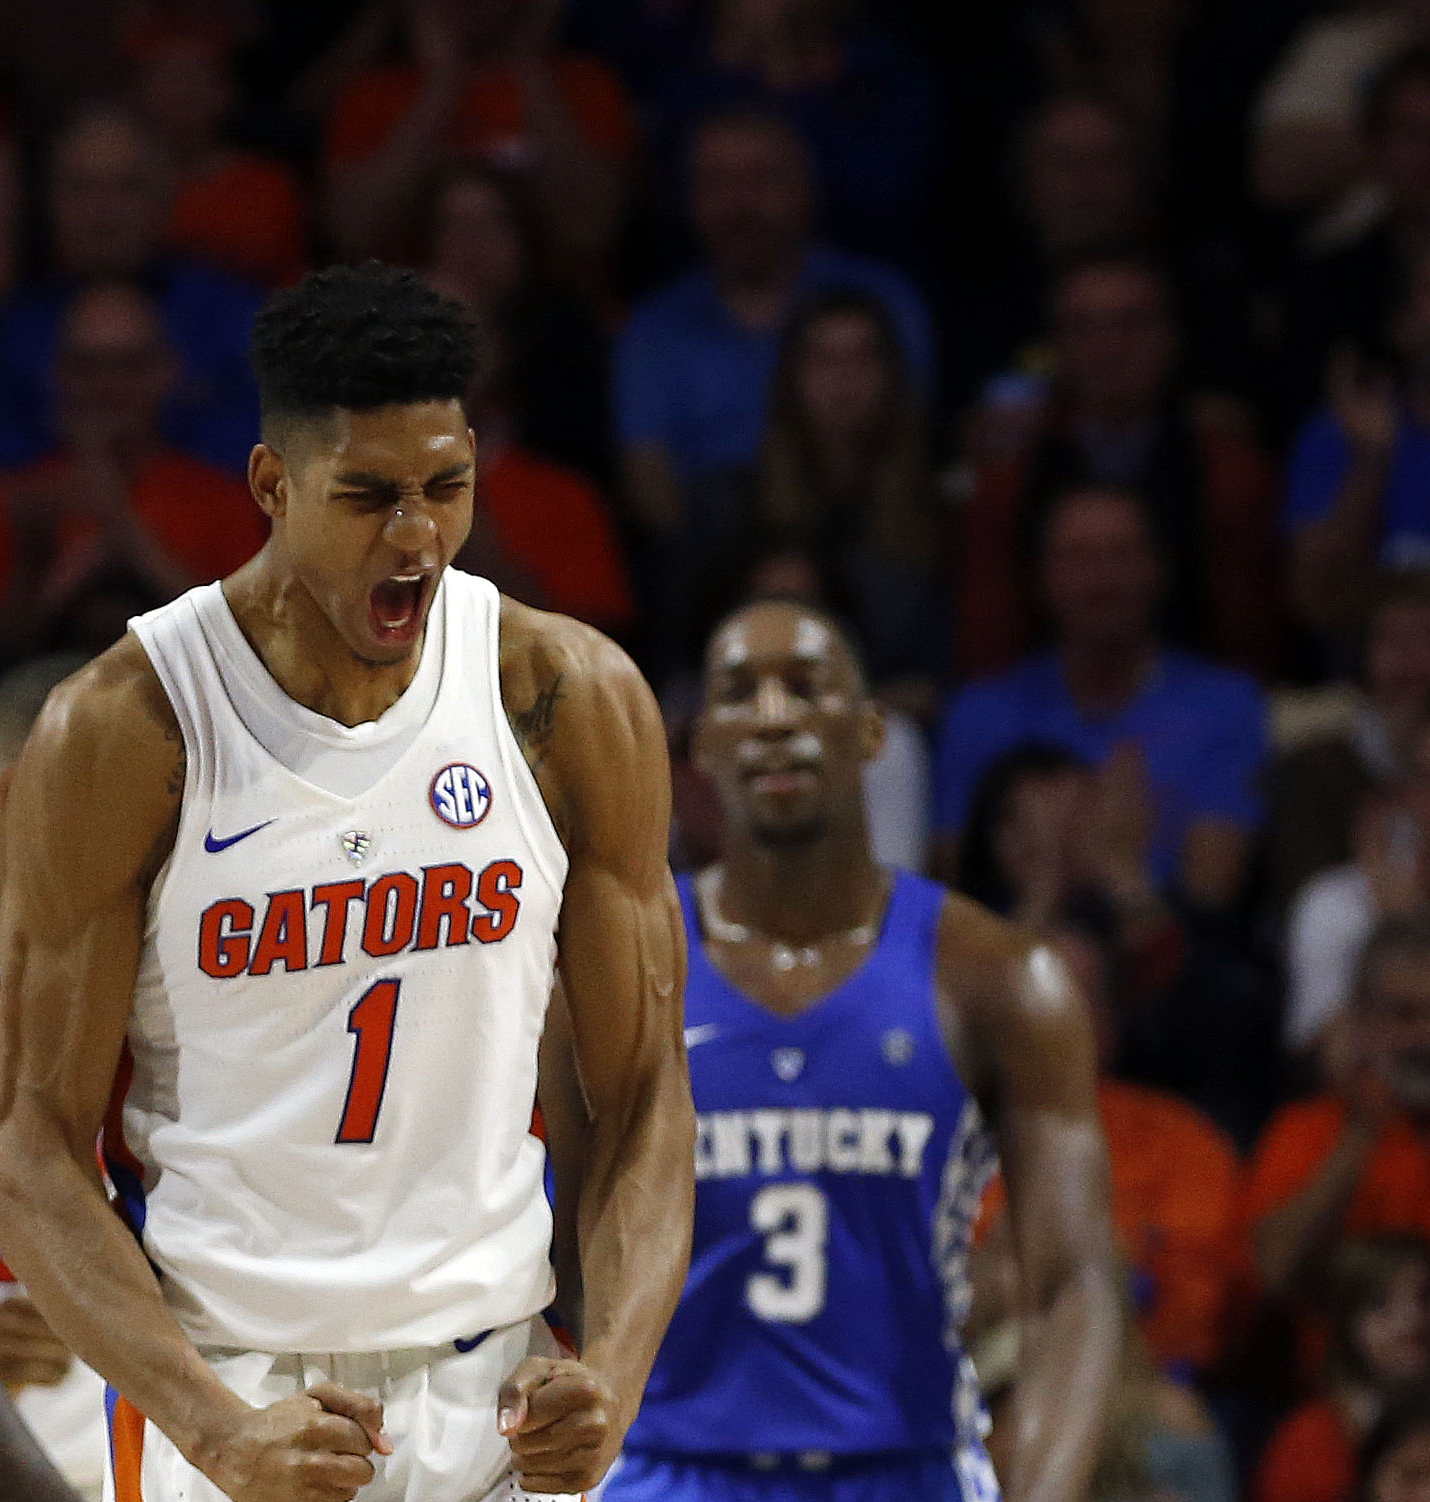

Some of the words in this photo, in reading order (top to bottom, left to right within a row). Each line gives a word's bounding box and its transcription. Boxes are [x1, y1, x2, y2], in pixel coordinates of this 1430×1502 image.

[432, 764, 491, 825] SEC
[198, 858, 524, 980] GATORS
[334, 976, 402, 1145] 1
[694, 1107, 935, 1180] ENTUCKY
[745, 1181, 830, 1325] 3
